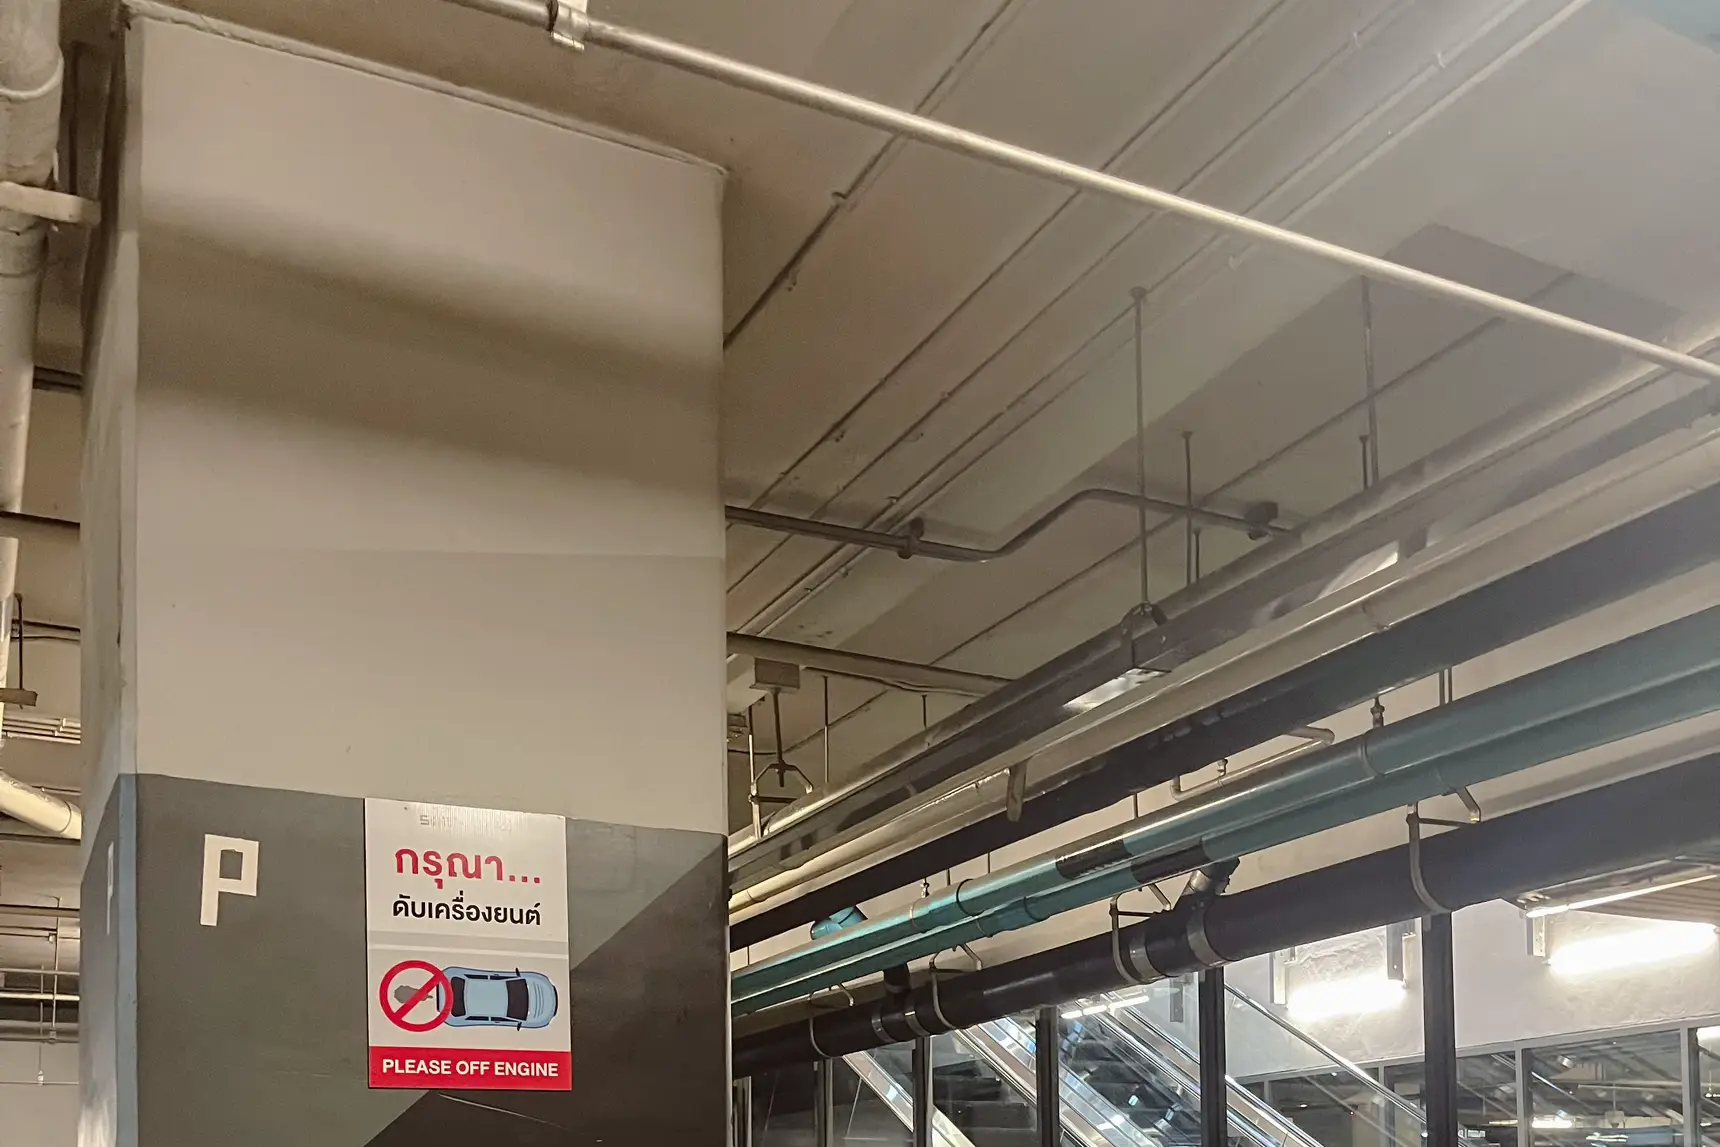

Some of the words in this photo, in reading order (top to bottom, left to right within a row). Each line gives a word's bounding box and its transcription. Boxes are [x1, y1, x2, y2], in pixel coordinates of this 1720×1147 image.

[200, 833, 259, 927] P
[395, 848, 541, 889] กรุณา...
[392, 890, 541, 925] ดับเครื่องยนต์
[382, 1059, 451, 1075] PLEASE
[456, 1061, 490, 1075] OFF
[494, 1062, 559, 1077] ENGINE
